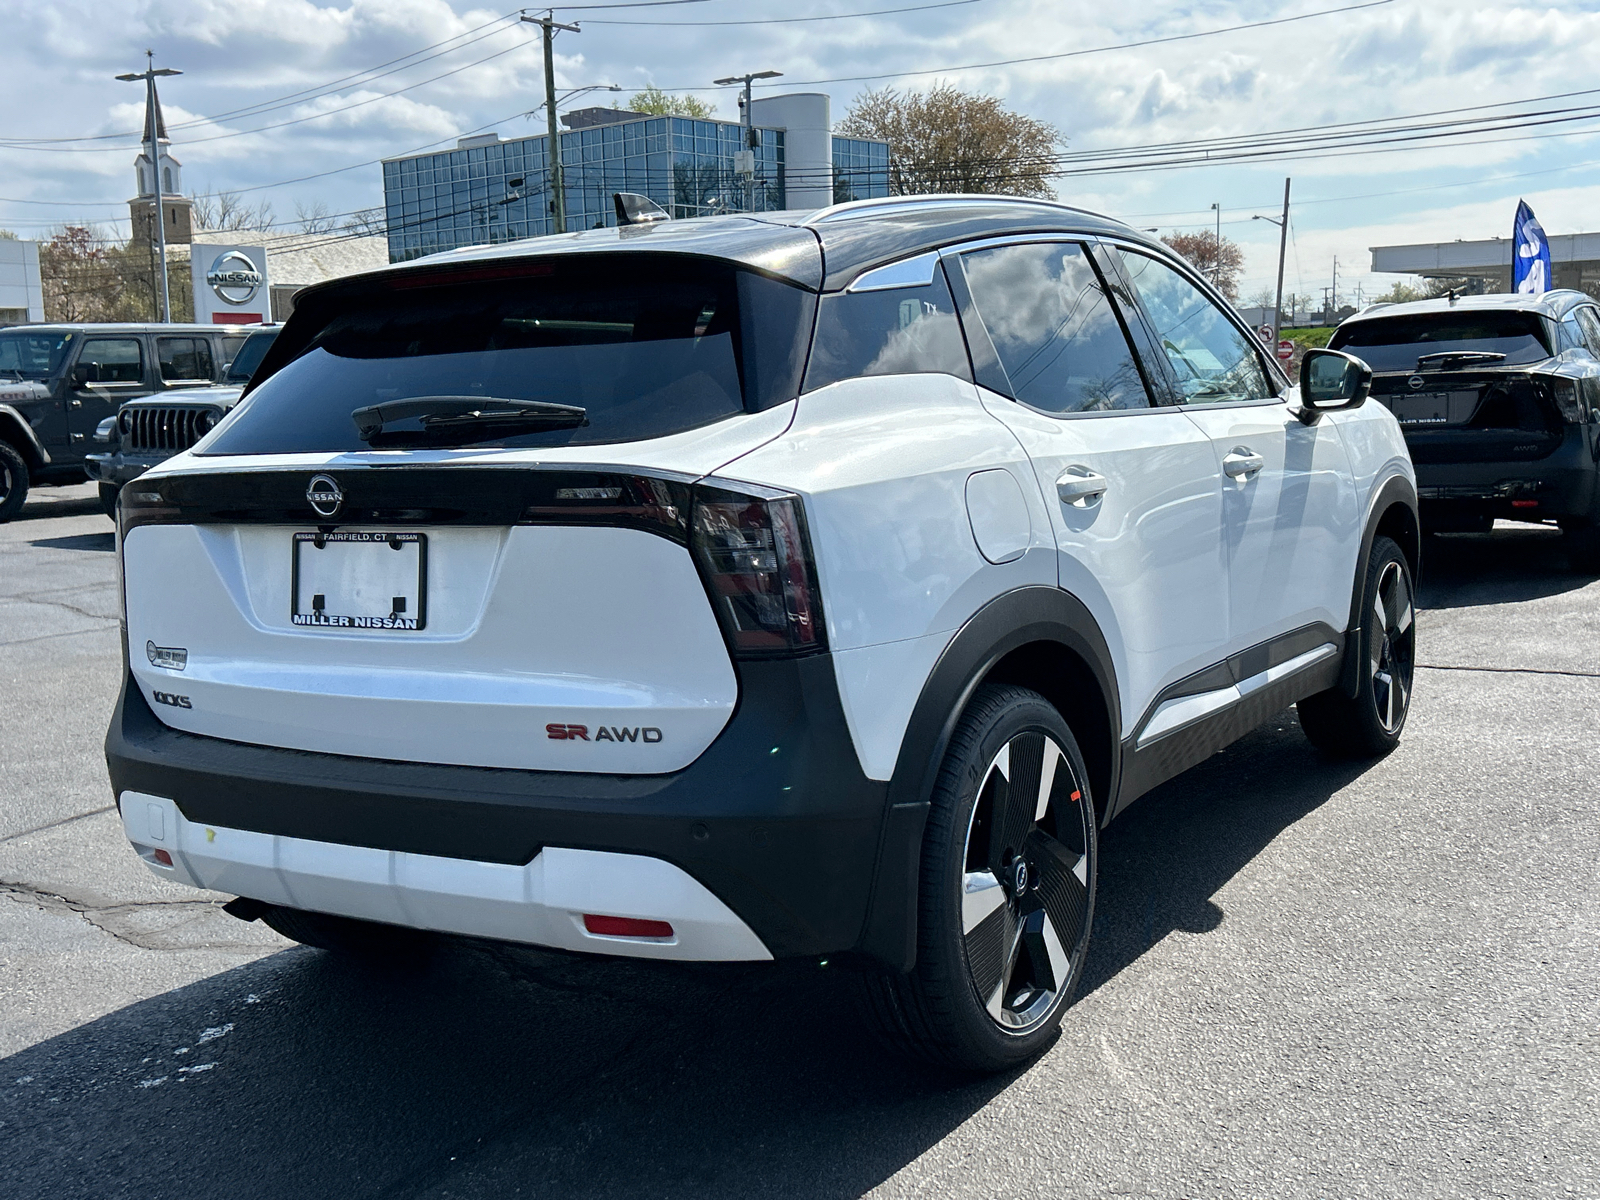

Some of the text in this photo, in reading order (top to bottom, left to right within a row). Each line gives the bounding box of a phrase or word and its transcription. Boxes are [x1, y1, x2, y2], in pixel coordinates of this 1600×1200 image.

[214, 273, 259, 283] NISSAN
[306, 493, 343, 501] NISSAN
[374, 533, 387, 541] CT
[293, 614, 417, 630] MILLER NISSAN
[545, 723, 663, 743] SR AWD
